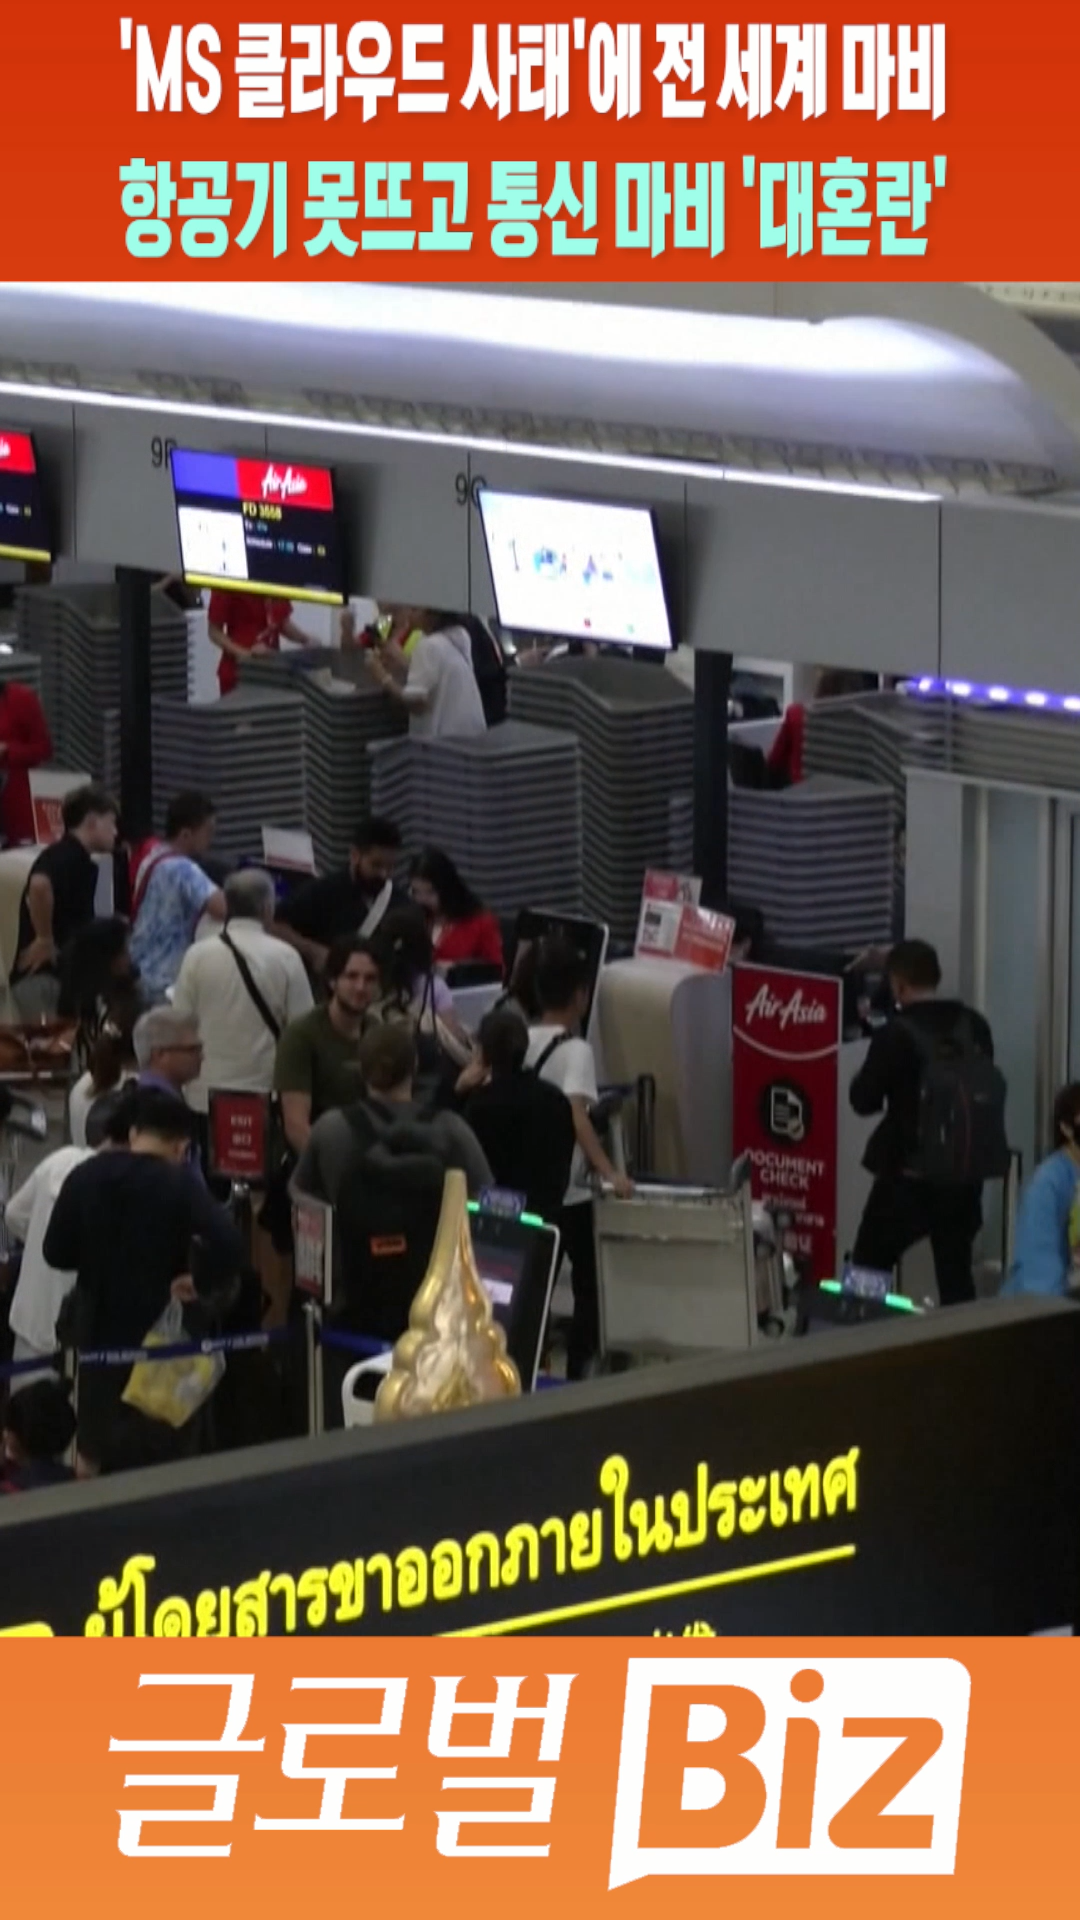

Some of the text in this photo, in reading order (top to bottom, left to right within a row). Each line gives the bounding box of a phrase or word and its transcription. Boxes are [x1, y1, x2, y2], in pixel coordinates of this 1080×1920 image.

[261, 463, 308, 501] AirAsia
[745, 983, 827, 1031] AirAsia
[759, 1169, 809, 1190] CHECK
